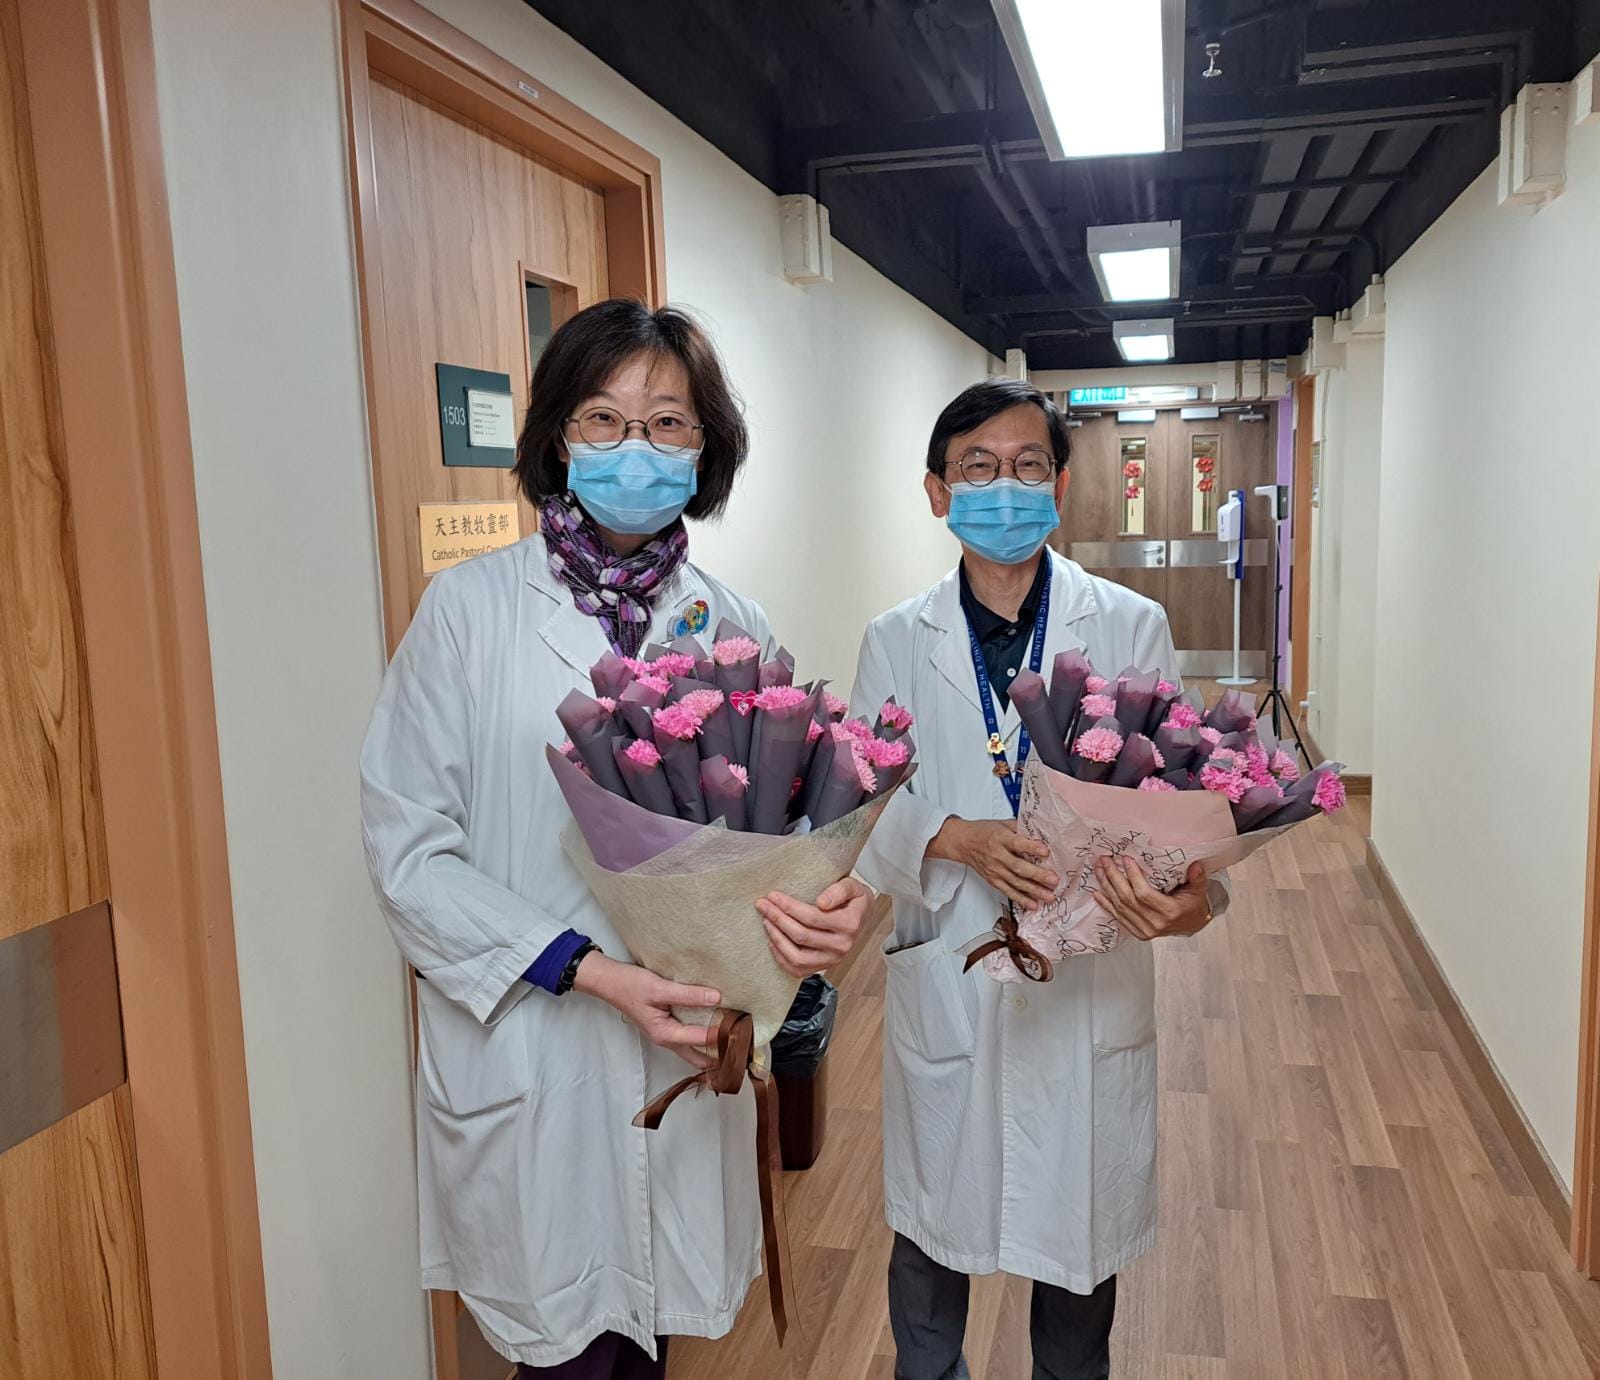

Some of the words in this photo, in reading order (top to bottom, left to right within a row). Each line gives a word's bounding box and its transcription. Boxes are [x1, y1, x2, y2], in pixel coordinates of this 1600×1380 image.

[442, 405, 466, 426] 1503
[431, 547, 459, 561] Catholic
[1033, 617, 1046, 657] HEALING
[978, 673, 992, 710] HEALTH
